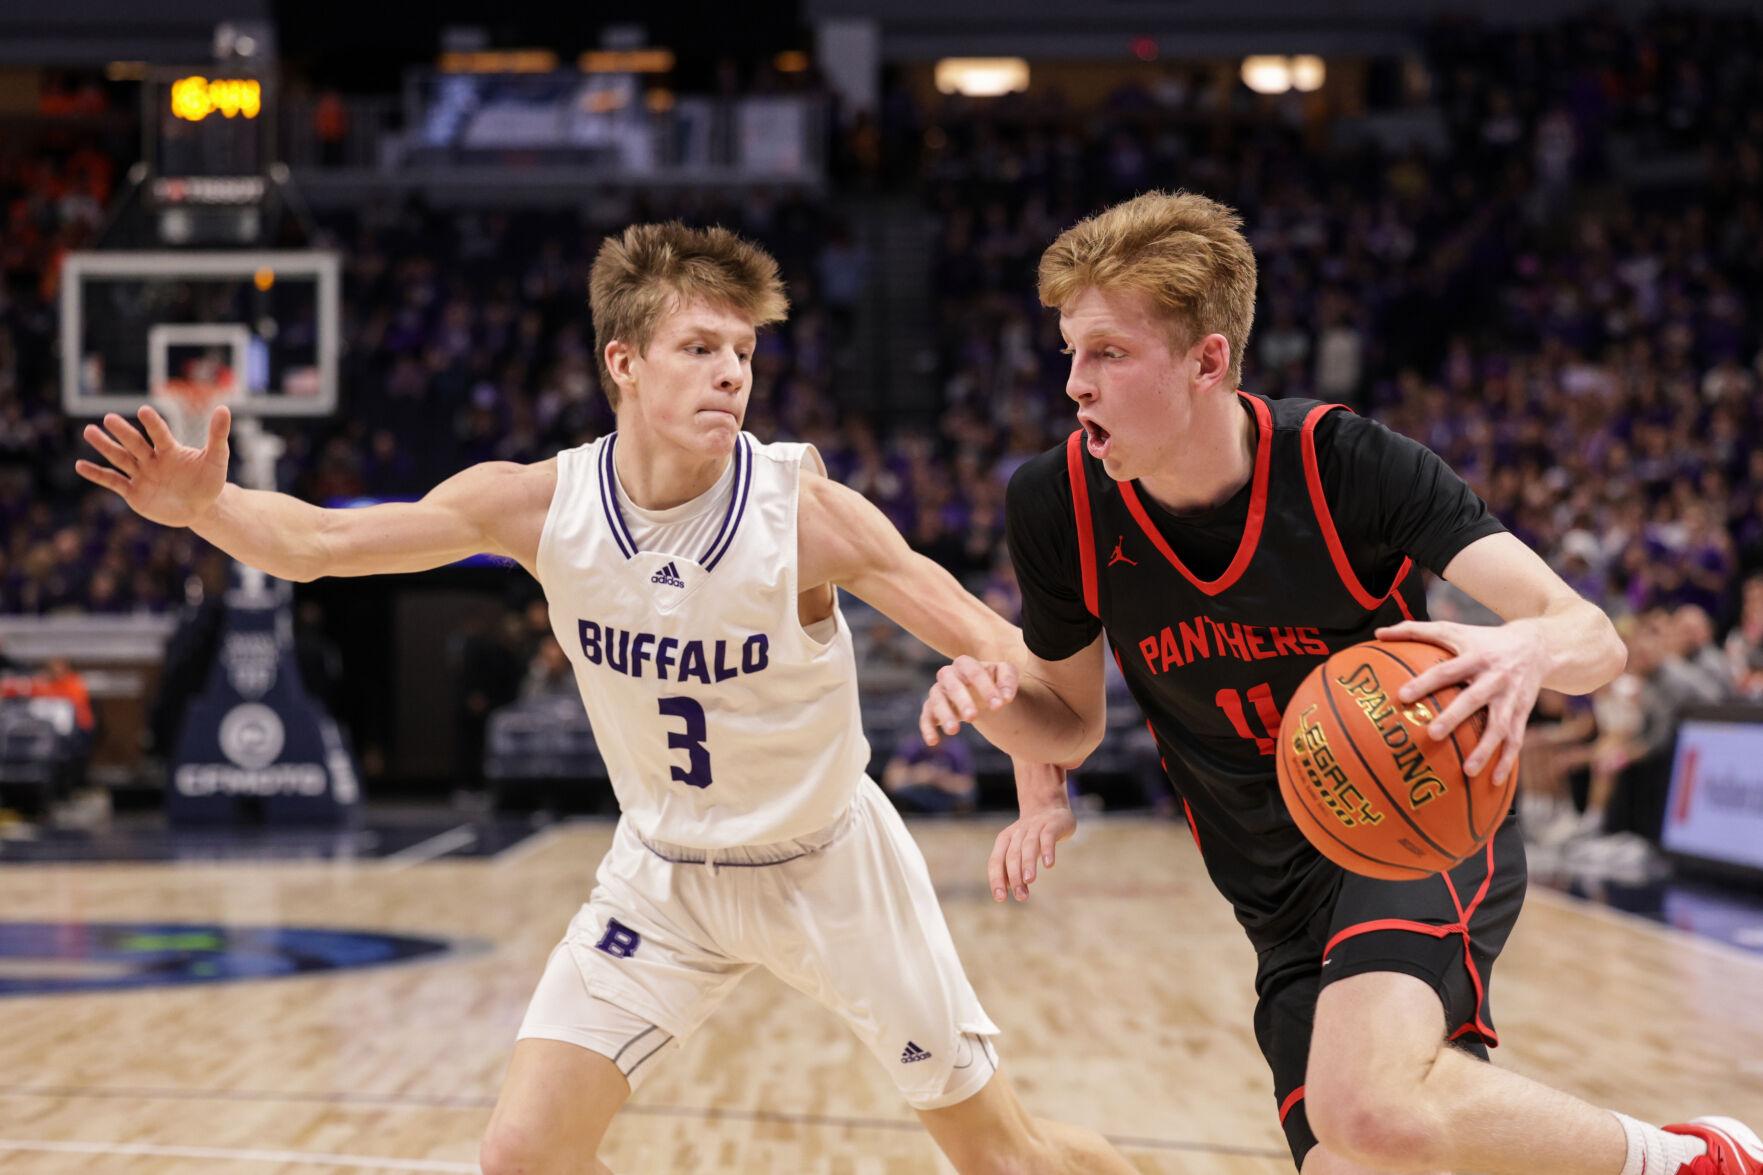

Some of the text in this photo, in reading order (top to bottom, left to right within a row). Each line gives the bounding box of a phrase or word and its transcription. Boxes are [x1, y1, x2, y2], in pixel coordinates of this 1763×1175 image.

[578, 618, 769, 684] BUFFALO
[1138, 615, 1330, 675] PANTHERS
[657, 696, 713, 789] 3
[1299, 703, 1384, 826] LEGACY
[1335, 662, 1447, 810] SPALDING
[594, 916, 641, 959] B
